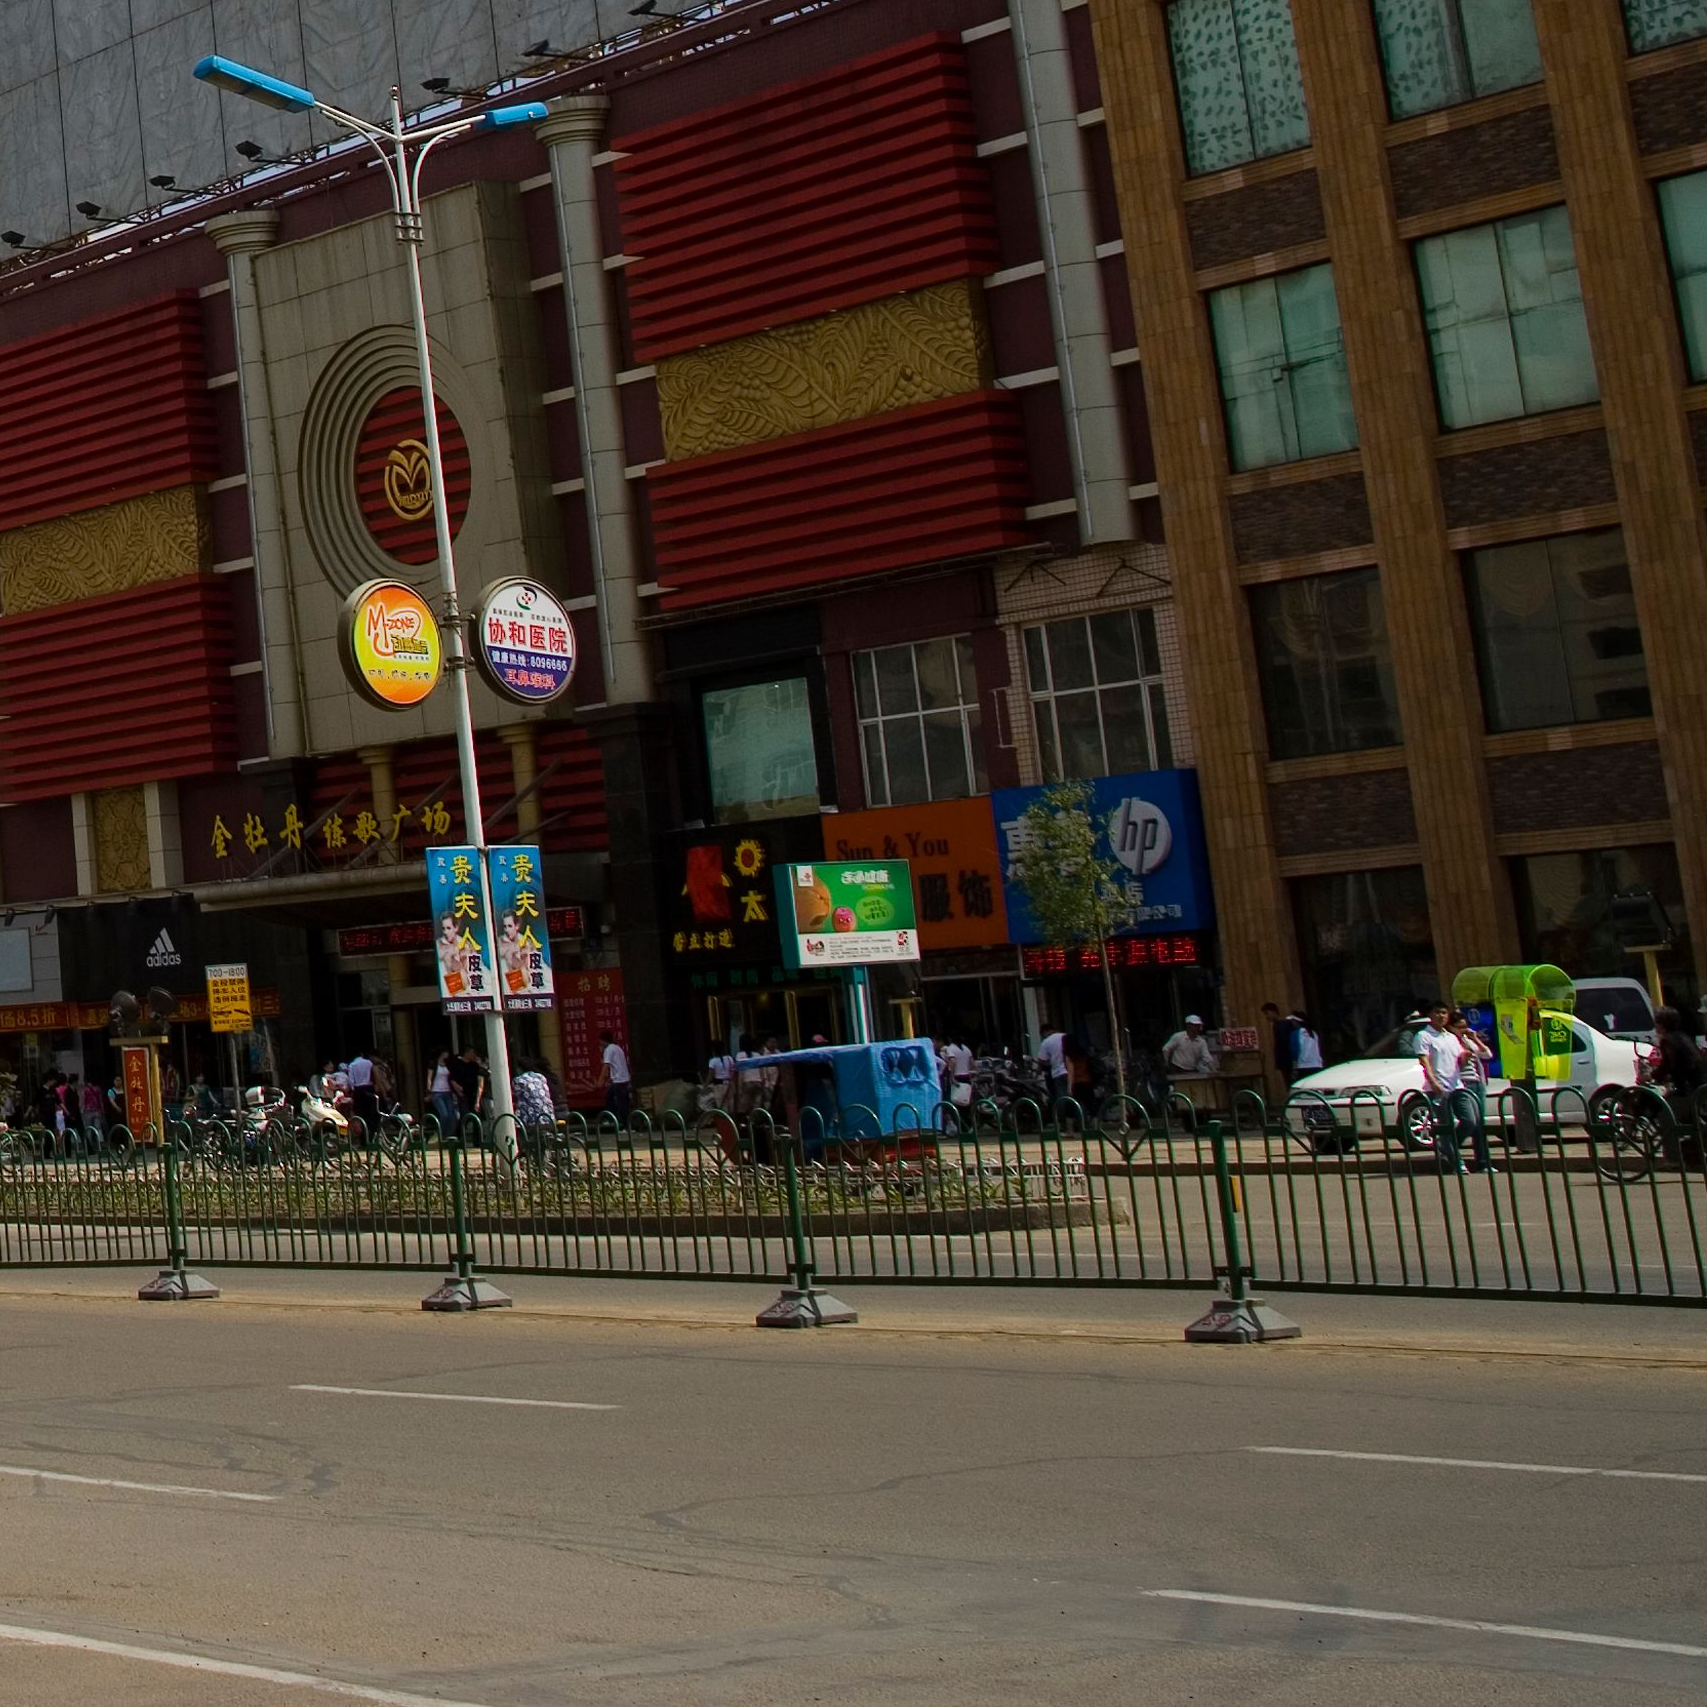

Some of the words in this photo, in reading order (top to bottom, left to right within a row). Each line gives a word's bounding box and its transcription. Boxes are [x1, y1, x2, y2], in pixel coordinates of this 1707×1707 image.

[489, 616, 568, 653] 协和医院
[210, 801, 452, 860] 金牡丹练歌广场
[884, 835, 898, 859] &
[904, 831, 949, 858] You
[1120, 797, 1158, 875] hp
[449, 855, 482, 951] 贵夫人
[510, 854, 542, 949] 贵夫人
[918, 868, 992, 922] 服饰
[145, 952, 182, 968] adidas
[468, 954, 484, 991] 皮草
[528, 952, 545, 989] 皮草
[577, 974, 611, 992] 招聘
